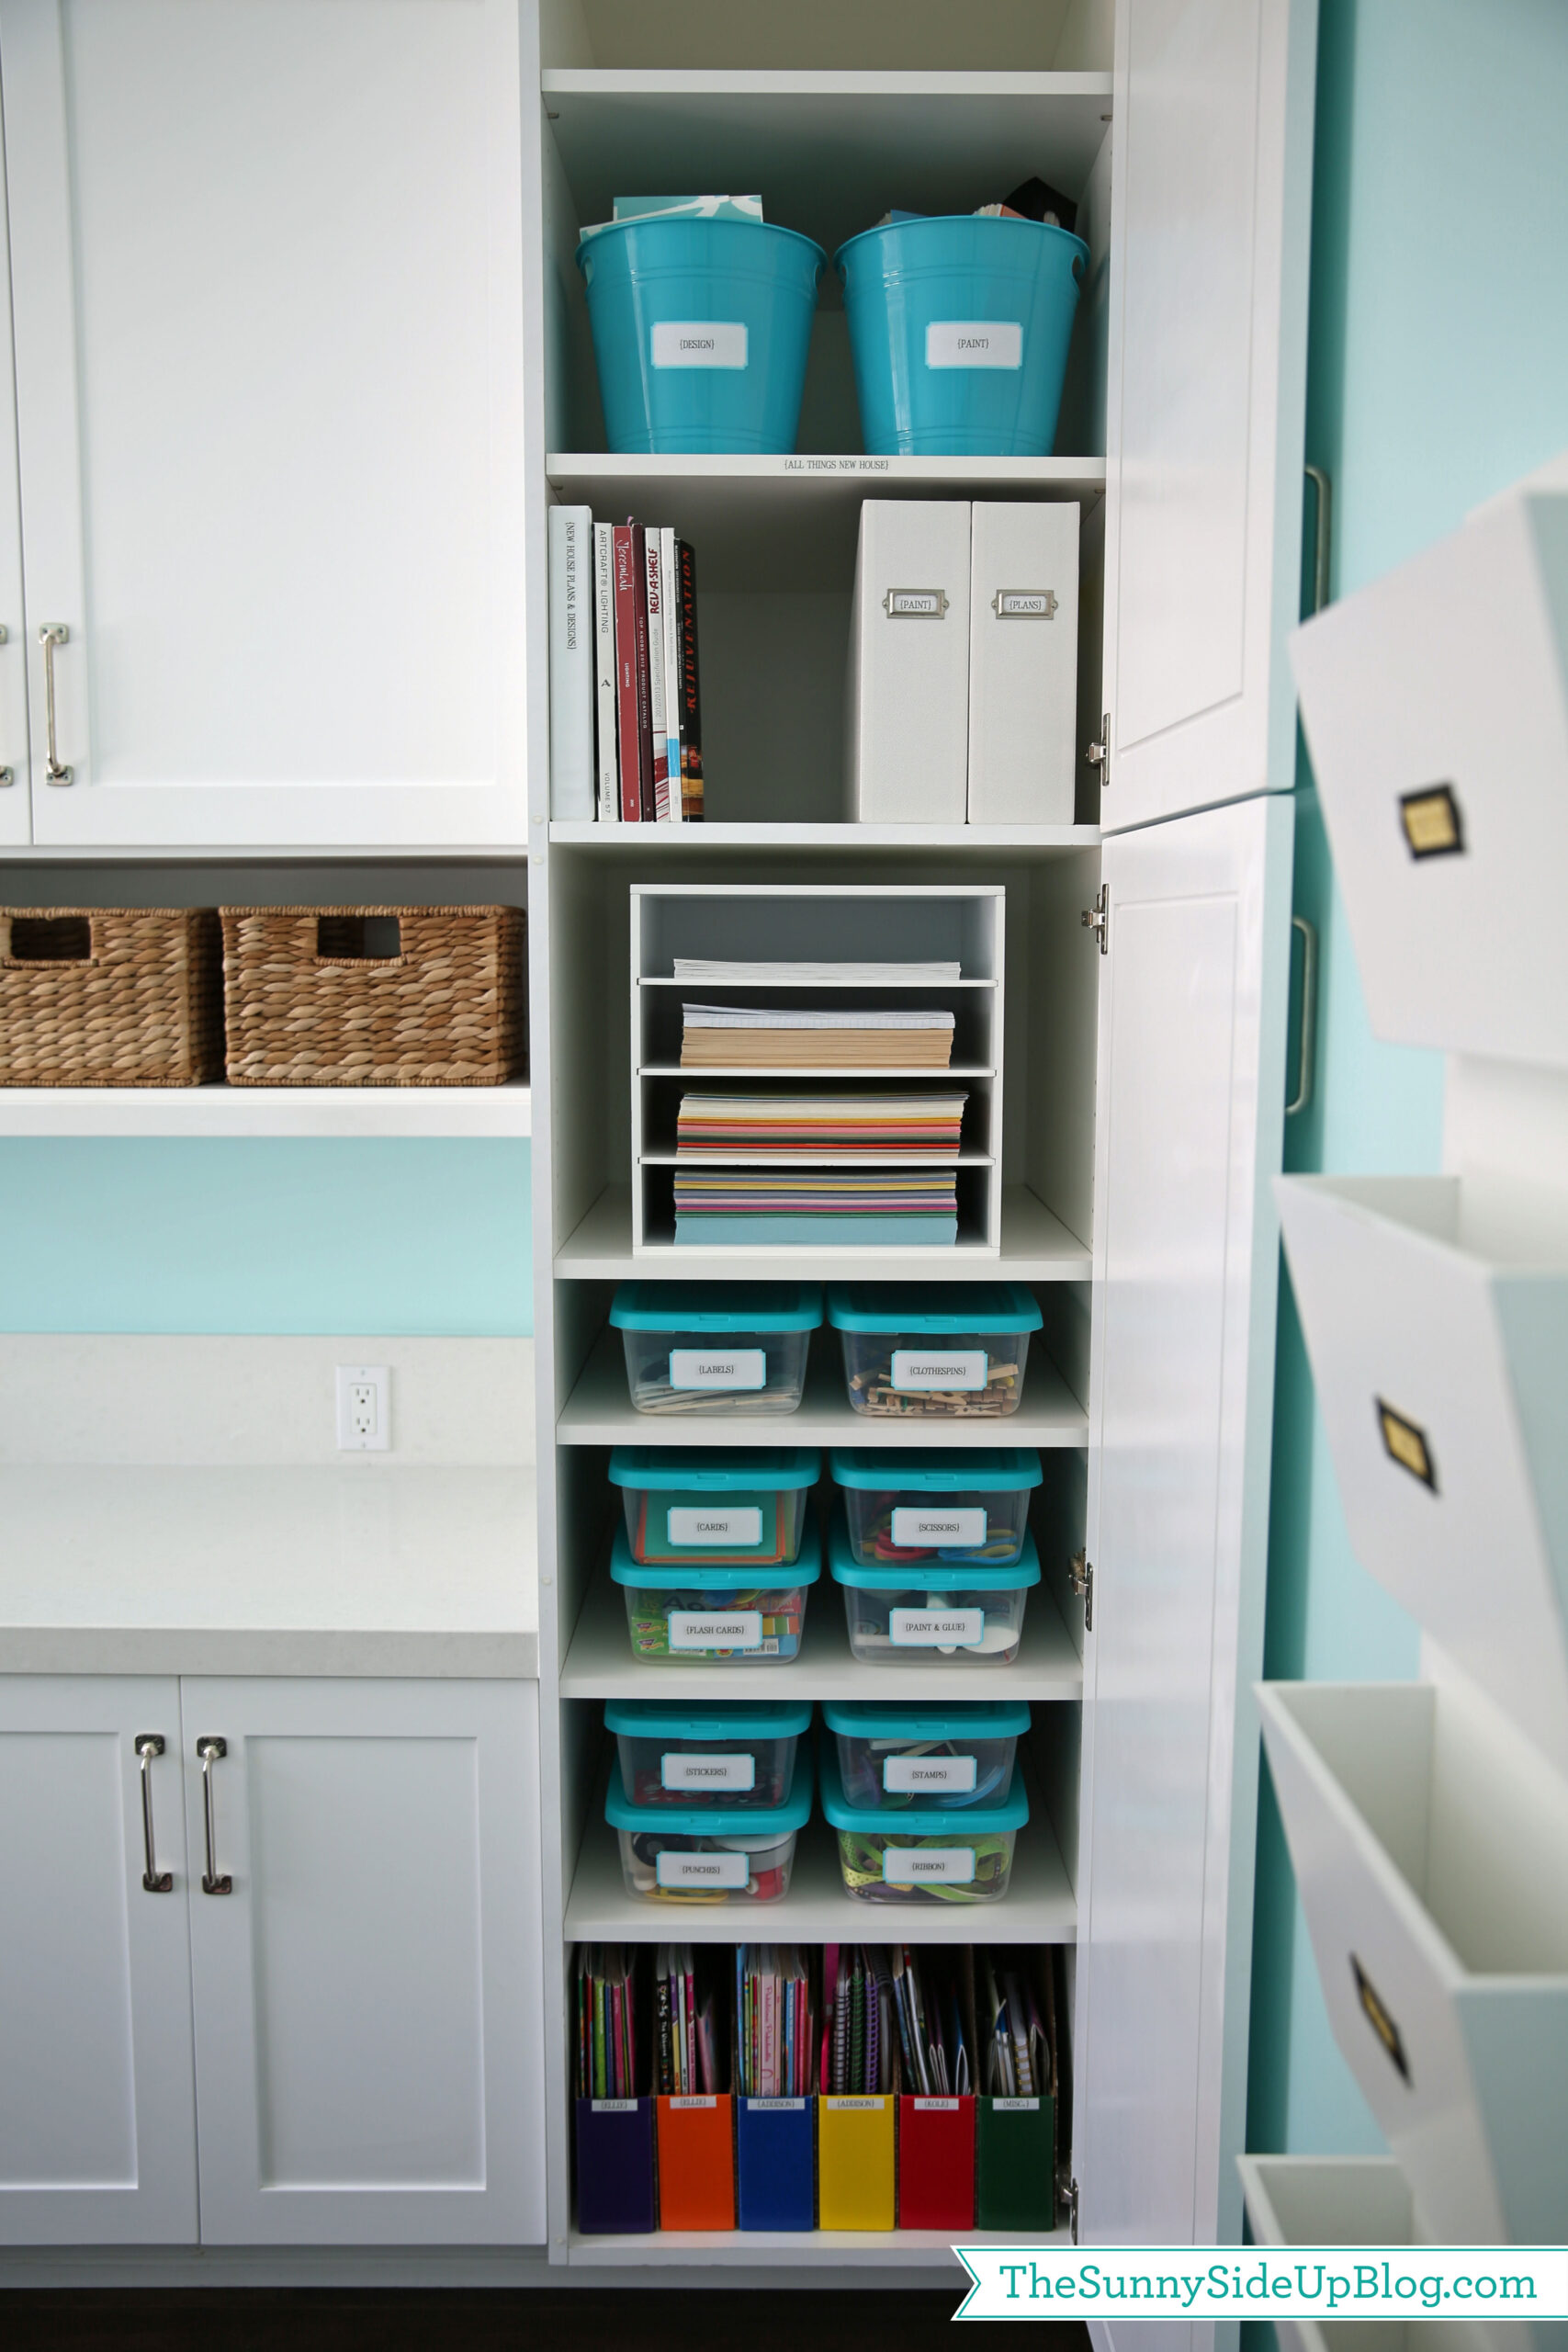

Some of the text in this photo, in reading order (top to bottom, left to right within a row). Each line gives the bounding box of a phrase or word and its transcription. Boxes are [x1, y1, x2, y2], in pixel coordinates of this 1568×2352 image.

[680, 339, 715, 351] {DESIGN}
[957, 338, 989, 350] {PAINT}
[784, 459, 889, 470] {ALL THINGS NEW HOUSE}
[566, 522, 576, 544] {NEW
[567, 546, 576, 571] HOUSE
[616, 539, 633, 591] Jeremiah
[567, 574, 576, 601] PLANS
[900, 600, 931, 610] {PAINT}
[1010, 600, 1042, 611] {PLANS}
[601, 590, 609, 634] LIGHTING
[567, 613, 577, 650] DESIGNS}
[682, 549, 696, 710] REJUVENATION
[652, 628, 662, 718] 2012/2013 Specification Guide
[605, 804, 611, 813] 57
[698, 1364, 735, 1375] {LABELS}
[909, 1365, 966, 1376] {CLOTHESPINS}
[696, 1521, 728, 1532] {CARDS}
[918, 1521, 960, 1532] {SCISSORS}
[686, 1625, 745, 1634] {FLASH CARDS}
[905, 1623, 965, 1632] {PAINT & GLUE}
[685, 1767, 728, 1777] {STICKERS}
[911, 1770, 948, 1780] {STAMPS}
[911, 1861, 945, 1871] {RIBBON}
